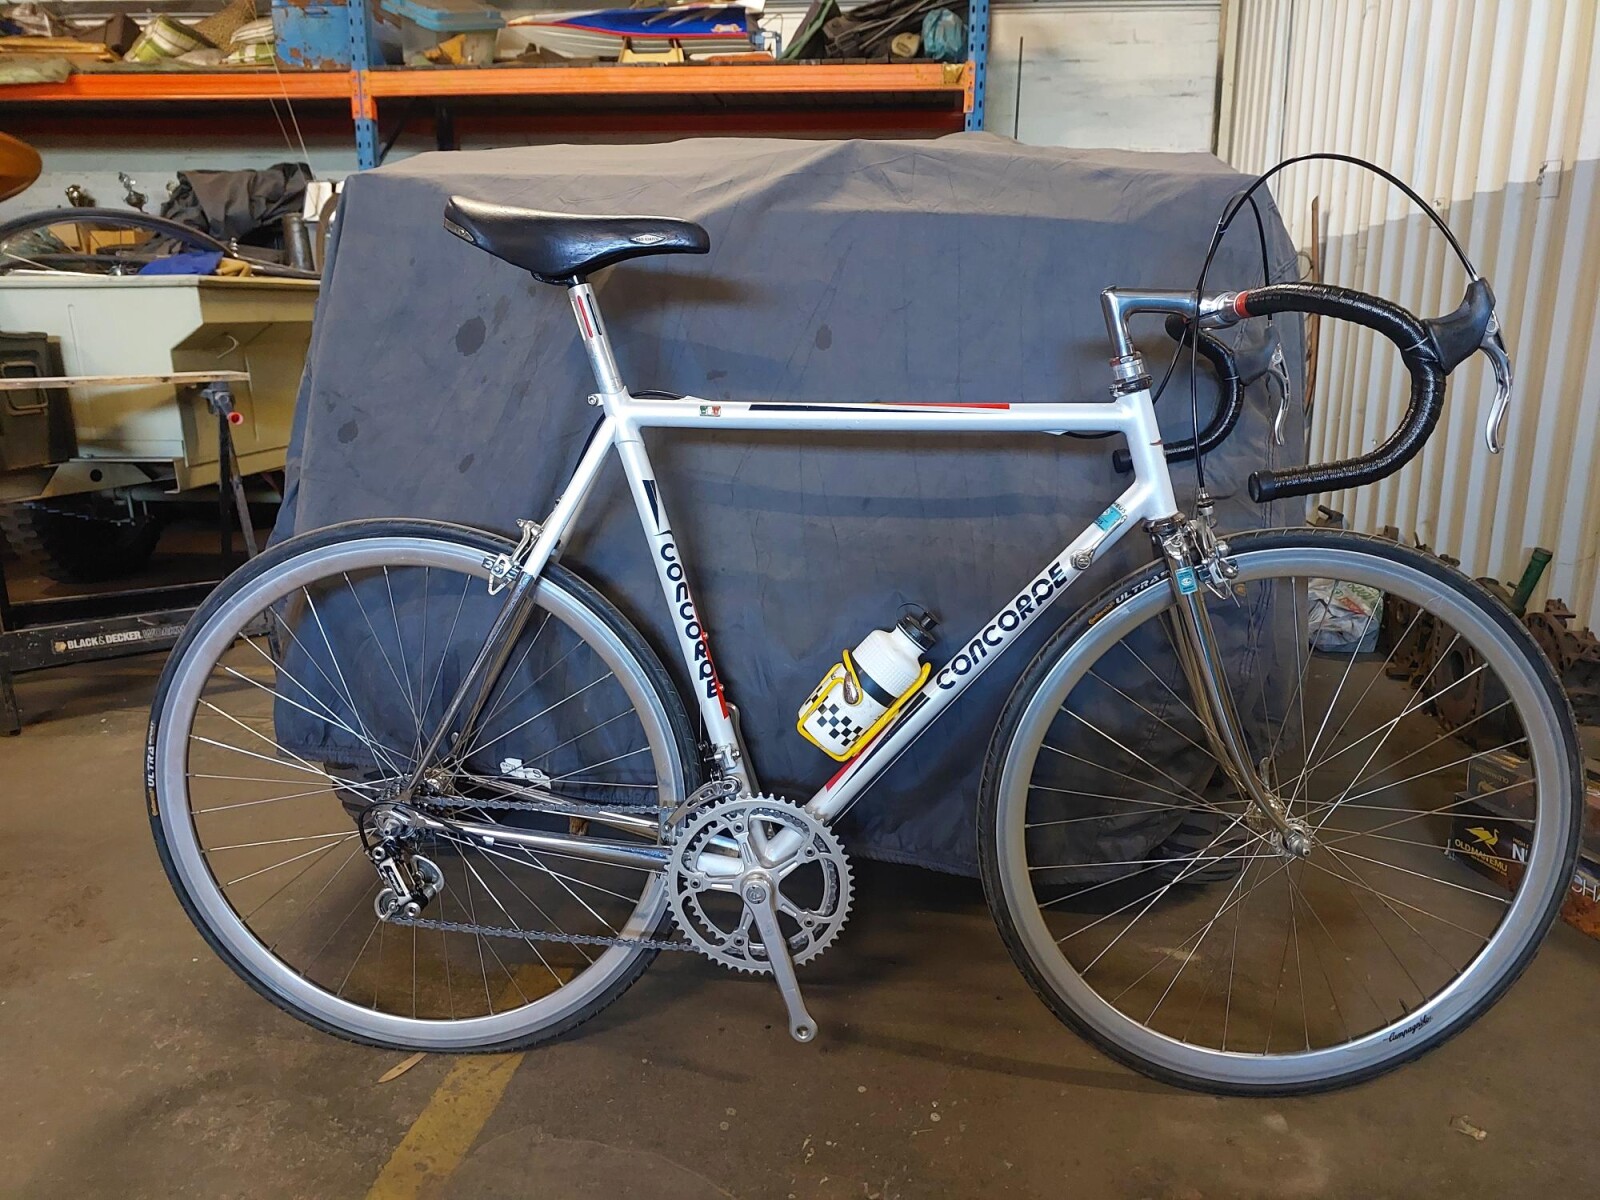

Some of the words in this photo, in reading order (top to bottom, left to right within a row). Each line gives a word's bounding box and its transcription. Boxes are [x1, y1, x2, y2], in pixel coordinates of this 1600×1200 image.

[660, 542, 719, 699] CONCORDE
[936, 561, 1068, 690] CONCORDE
[1115, 575, 1160, 604] ULTRA
[147, 745, 155, 788] ULTRA
